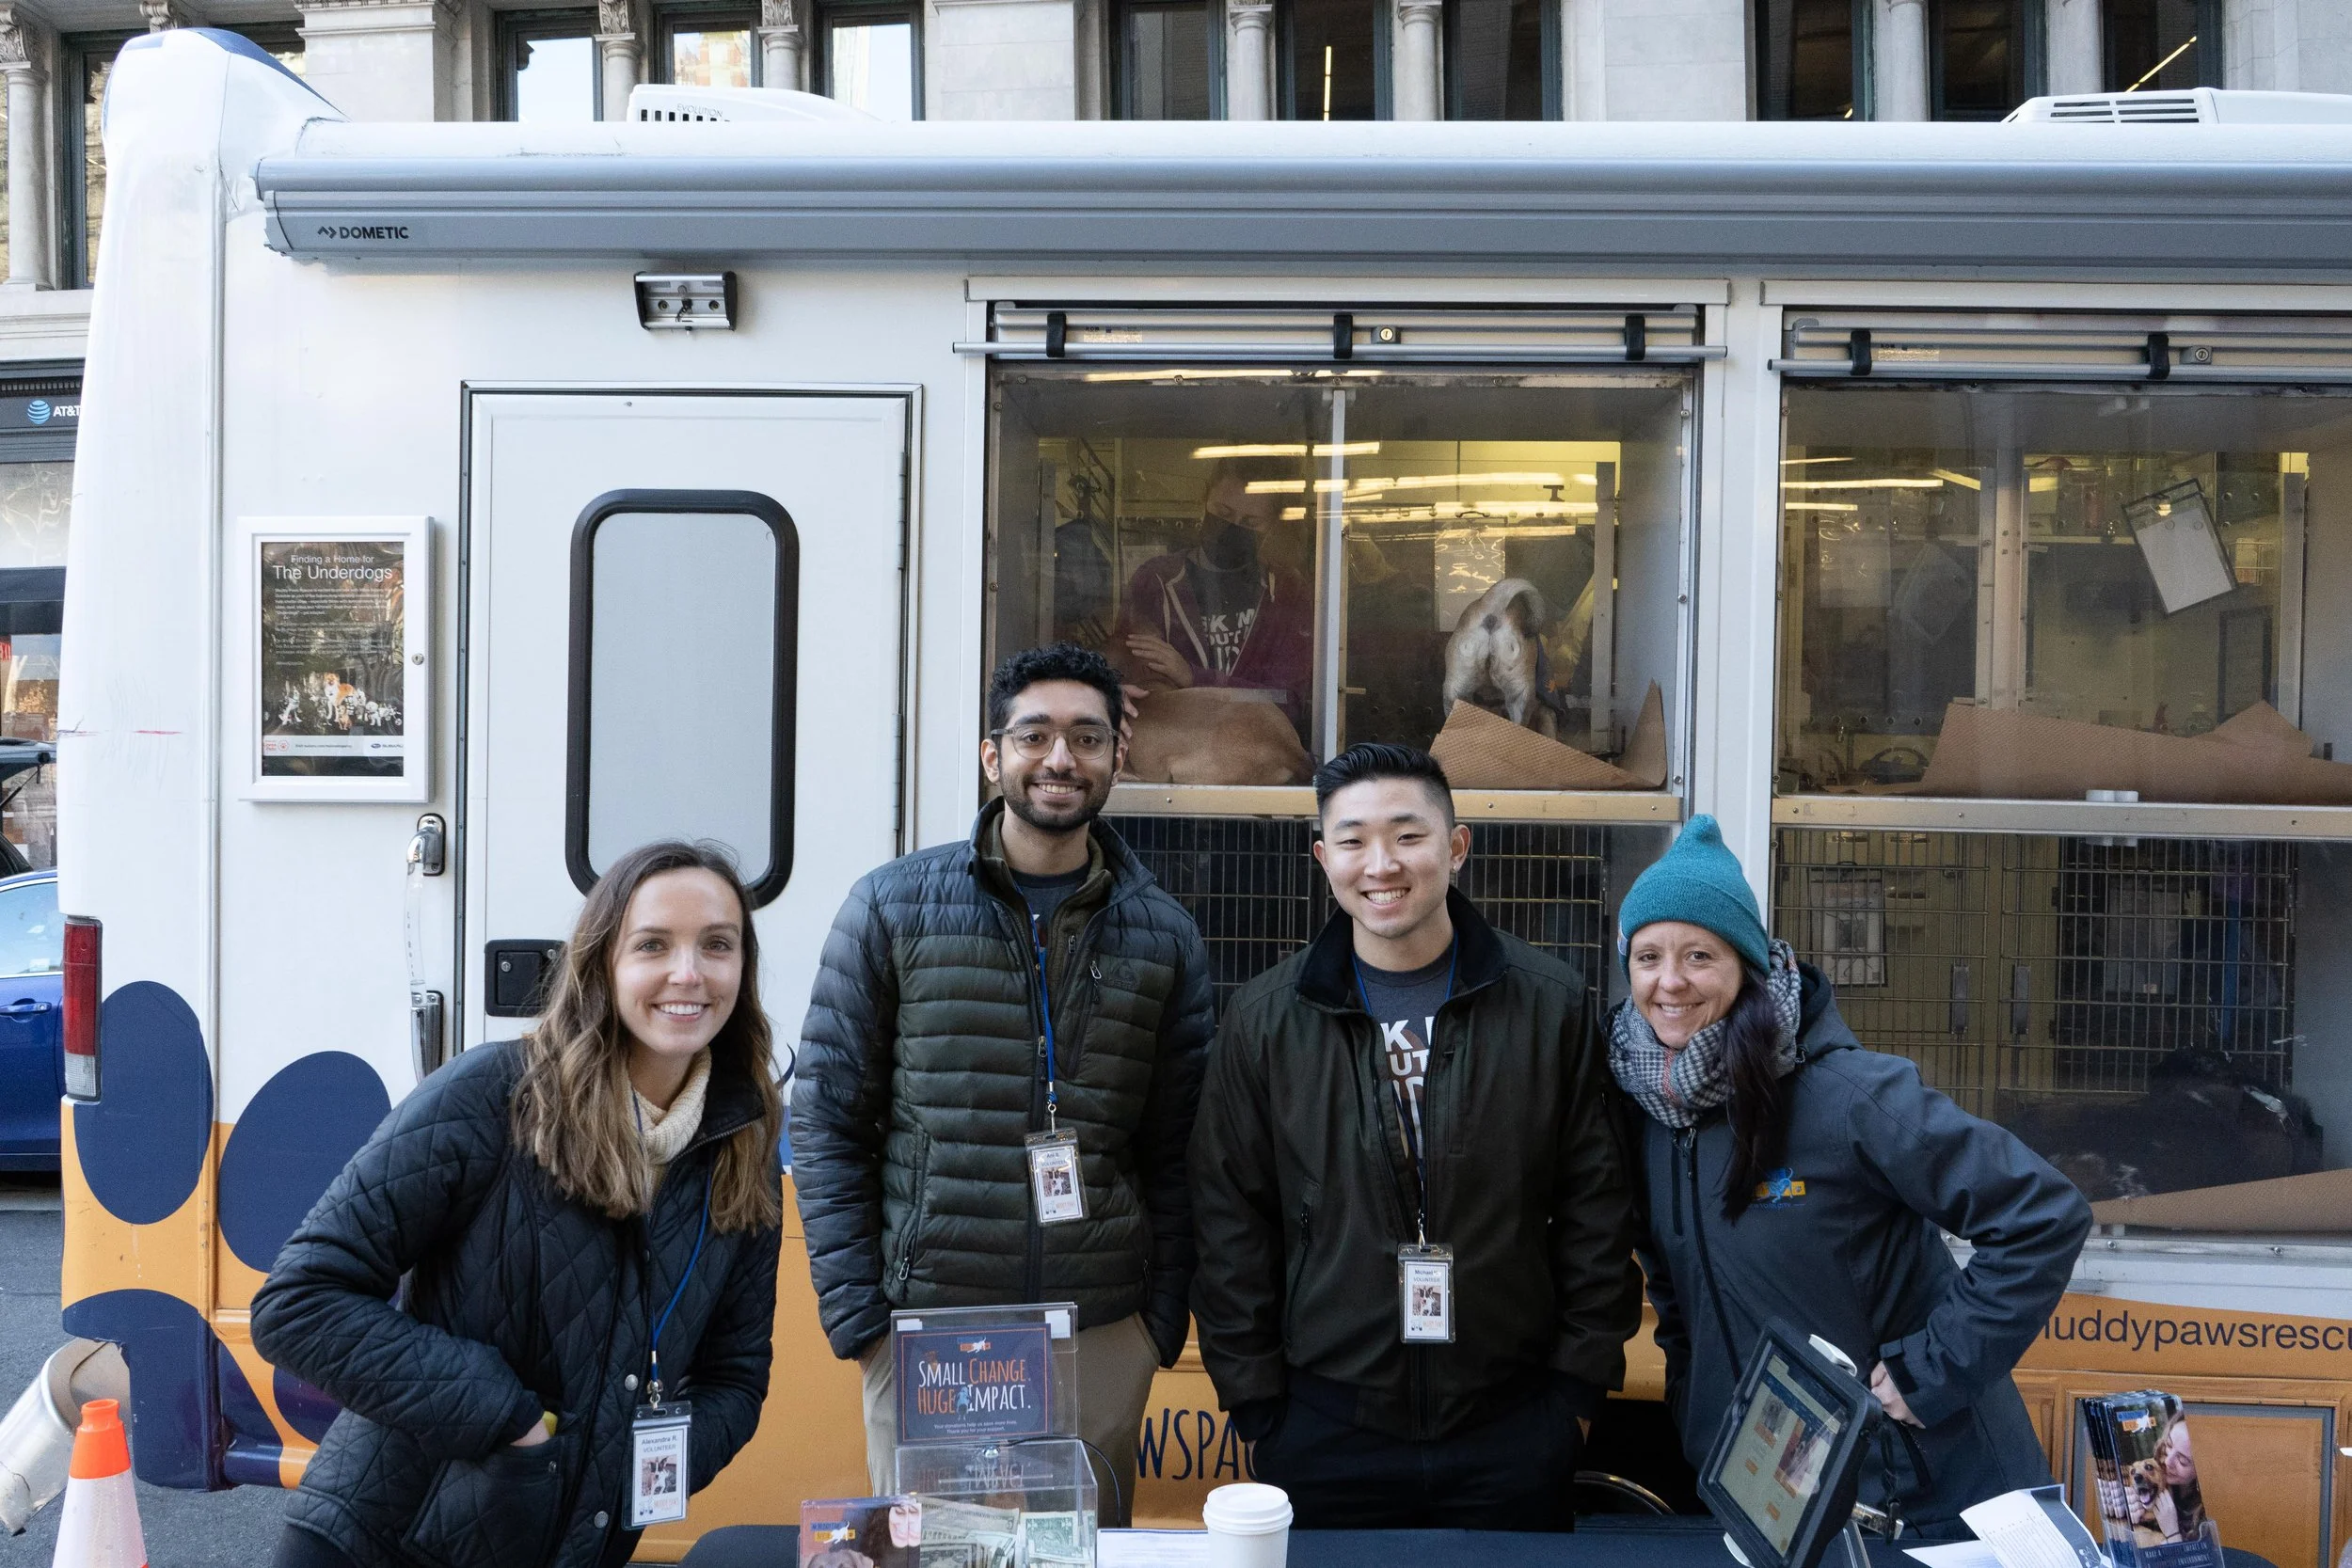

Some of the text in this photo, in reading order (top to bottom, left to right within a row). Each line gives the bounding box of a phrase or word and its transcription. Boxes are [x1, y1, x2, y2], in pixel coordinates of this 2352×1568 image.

[676, 103, 723, 118] EVOLUTION
[339, 226, 409, 239] DOMETIC
[53, 404, 82, 417] AT&T
[291, 554, 323, 565] Finding
[334, 554, 360, 563] Home
[362, 554, 374, 563] for
[273, 564, 392, 582] The Underdogs
[918, 1358, 1031, 1387] SMALL CHANGE.
[917, 1384, 1031, 1415] HUGE IMPACT.
[642, 1436, 671, 1445] Alexandra
[644, 1444, 676, 1452] VOLUNTEER
